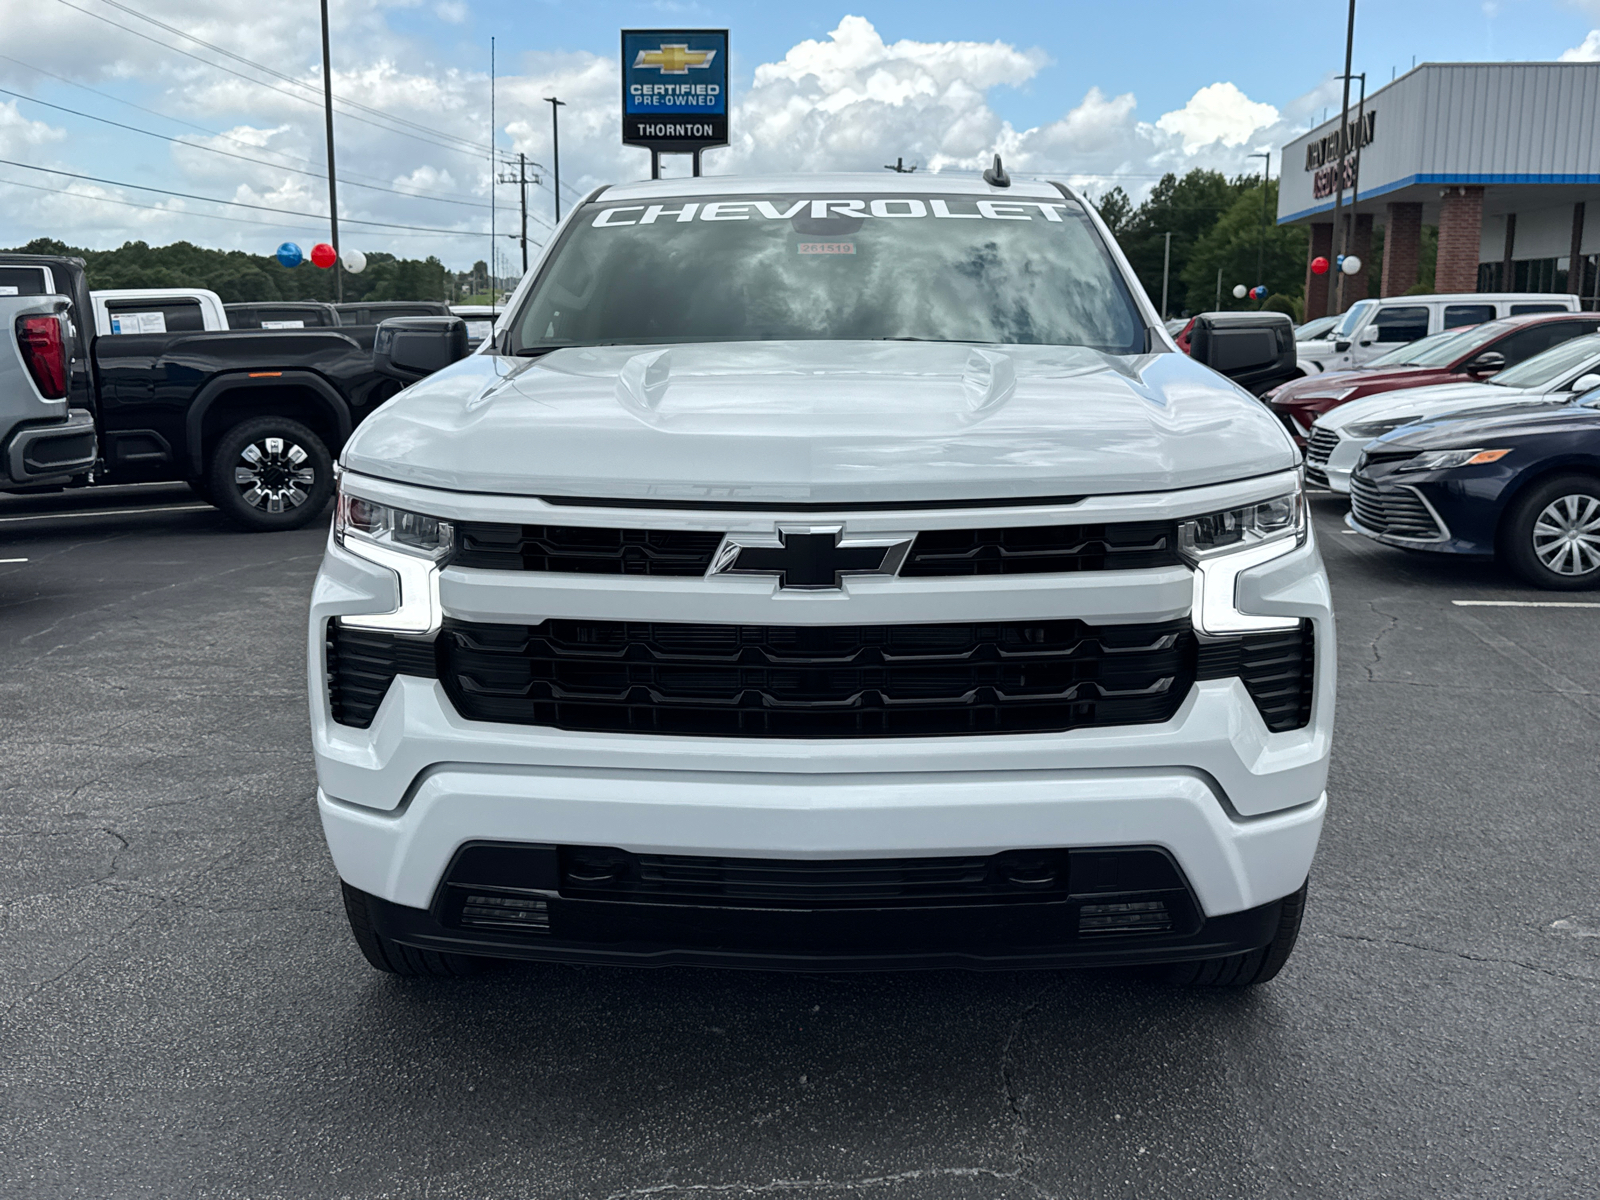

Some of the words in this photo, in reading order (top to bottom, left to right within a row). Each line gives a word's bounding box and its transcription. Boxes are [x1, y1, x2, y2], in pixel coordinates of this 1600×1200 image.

[630, 84, 720, 95] CERTIFIED
[634, 95, 715, 106] PRE-OWNED
[637, 124, 713, 136] THORNTON
[591, 199, 1067, 228] CHEVROLET
[802, 244, 852, 253] 261519
